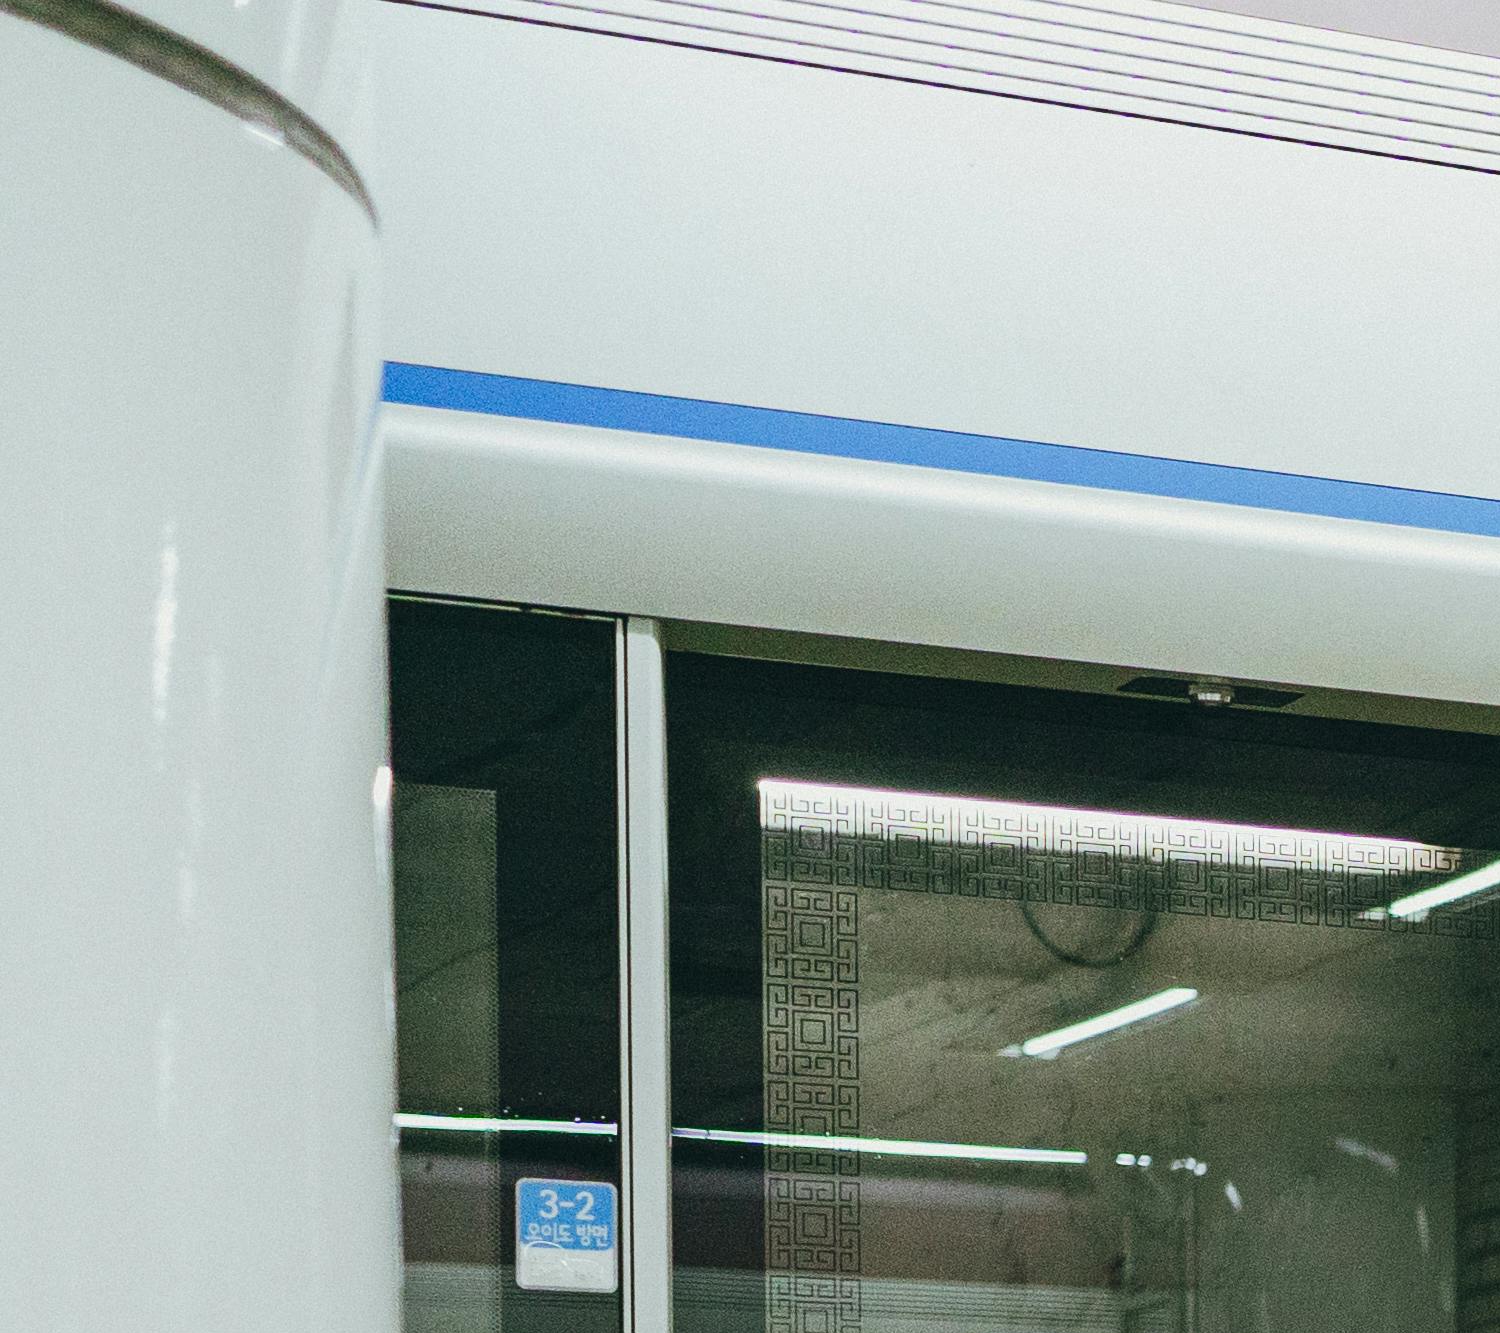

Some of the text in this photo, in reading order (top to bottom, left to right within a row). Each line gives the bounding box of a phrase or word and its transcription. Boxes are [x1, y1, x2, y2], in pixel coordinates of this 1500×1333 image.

[538, 1189, 596, 1221] 3-2
[527, 1222, 609, 1247] 오이도 방면
